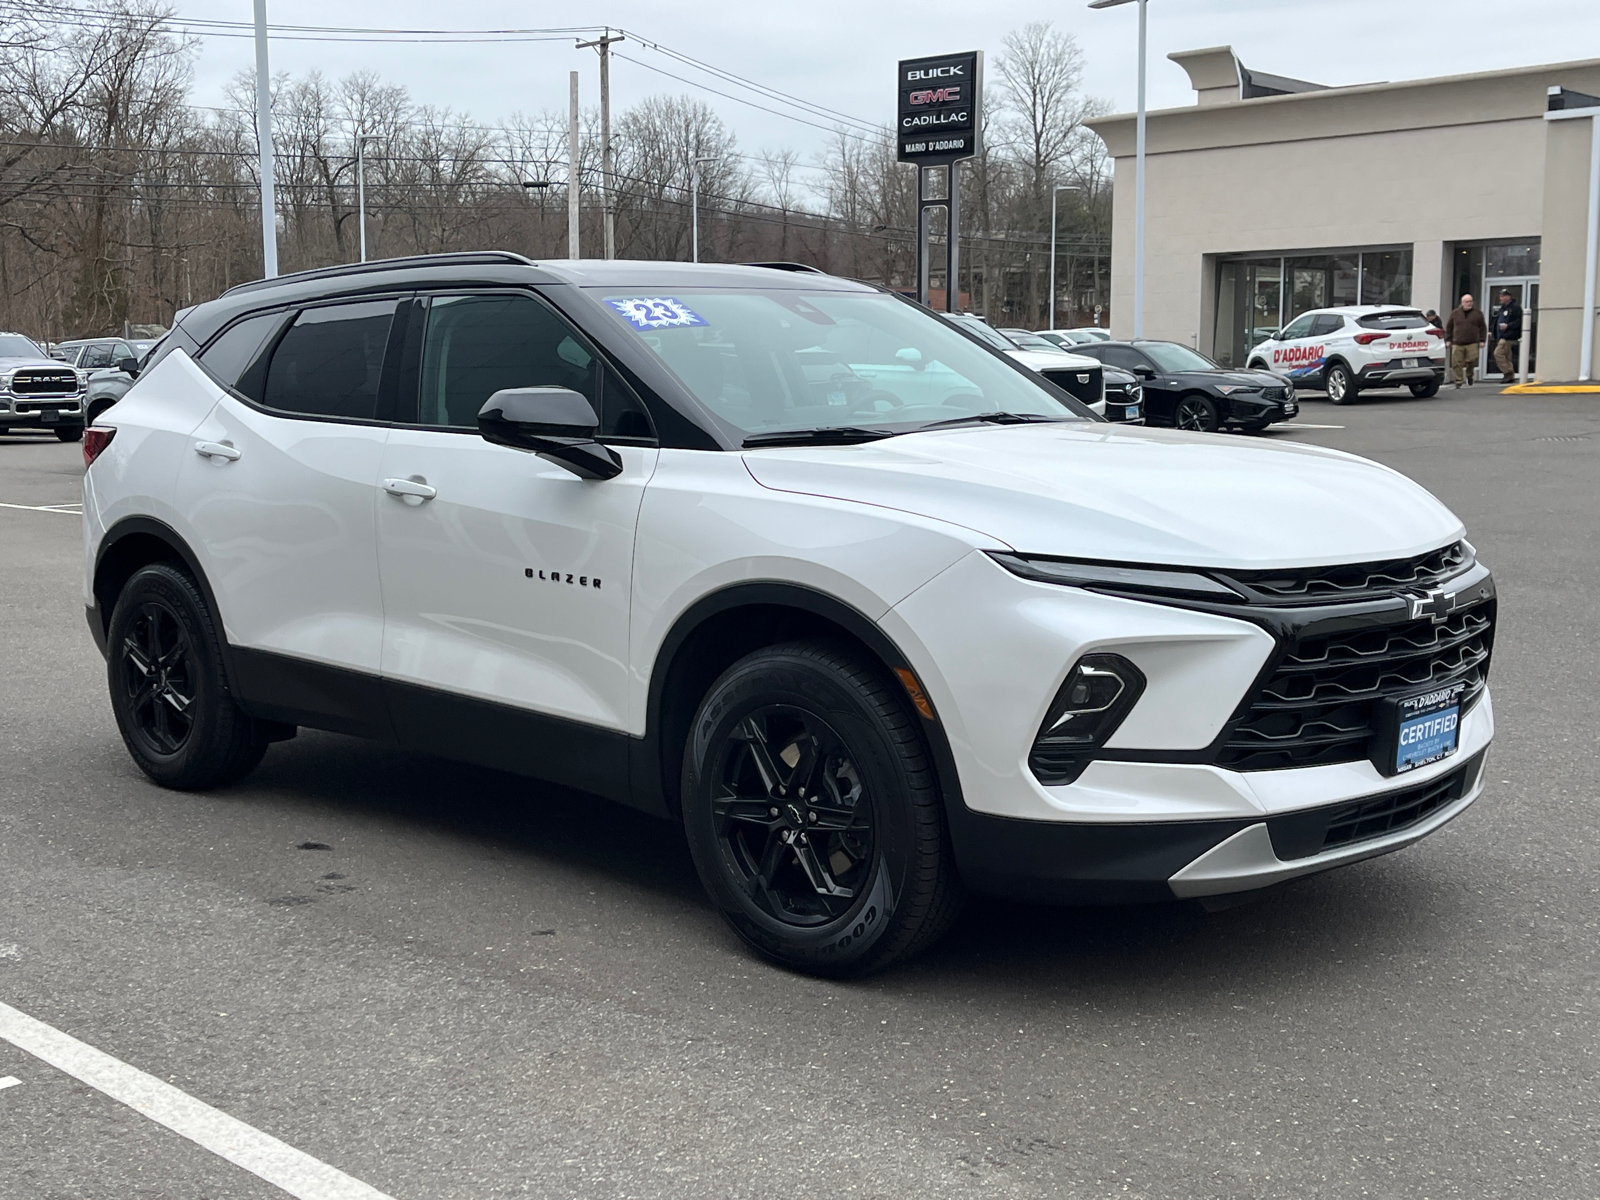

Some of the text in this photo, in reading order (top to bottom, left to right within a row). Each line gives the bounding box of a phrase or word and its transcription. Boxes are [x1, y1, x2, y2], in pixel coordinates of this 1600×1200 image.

[907, 65, 964, 81] BUICK
[910, 87, 961, 105] GMC
[903, 112, 968, 127] CADILLAC
[905, 139, 965, 153] MARIO D'ADDARIO
[633, 302, 679, 321] 23
[1273, 345, 1324, 363] D'ADDARIO
[1389, 340, 1429, 350] D'ADDARIO
[525, 567, 601, 589] BLAZER
[1400, 714, 1458, 746] CERTIFIED
